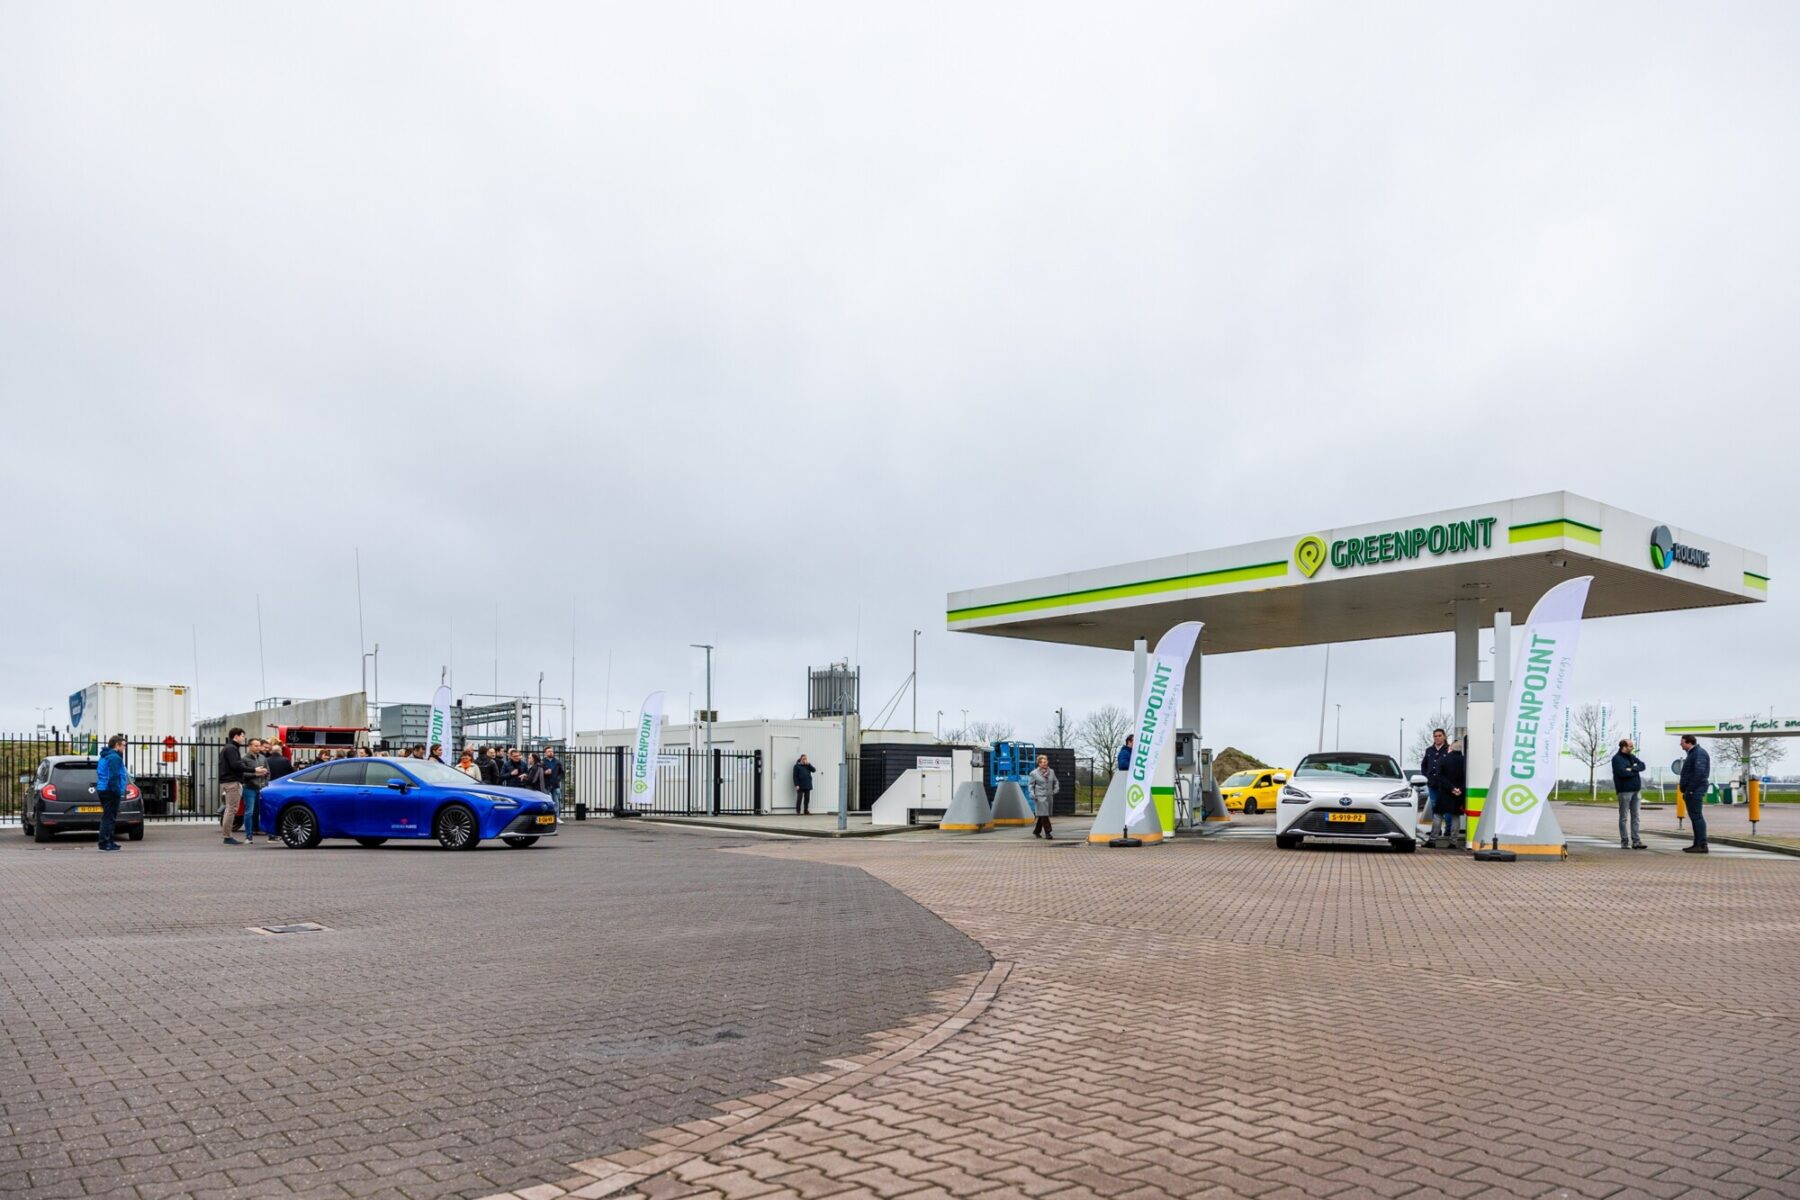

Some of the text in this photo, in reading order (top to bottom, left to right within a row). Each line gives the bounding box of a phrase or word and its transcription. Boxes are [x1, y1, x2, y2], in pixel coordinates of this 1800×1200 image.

[1331, 517, 1497, 568] GREENPOINT
[1673, 543, 1710, 568] ROLANDE
[431, 707, 444, 744] POINT
[1133, 662, 1172, 782] GREENPOINT
[1511, 633, 1556, 780] GREENPOINT
[1718, 722, 1744, 731] Pure
[1750, 719, 1778, 732] fuels
[635, 711, 653, 778] GREENPOINT
